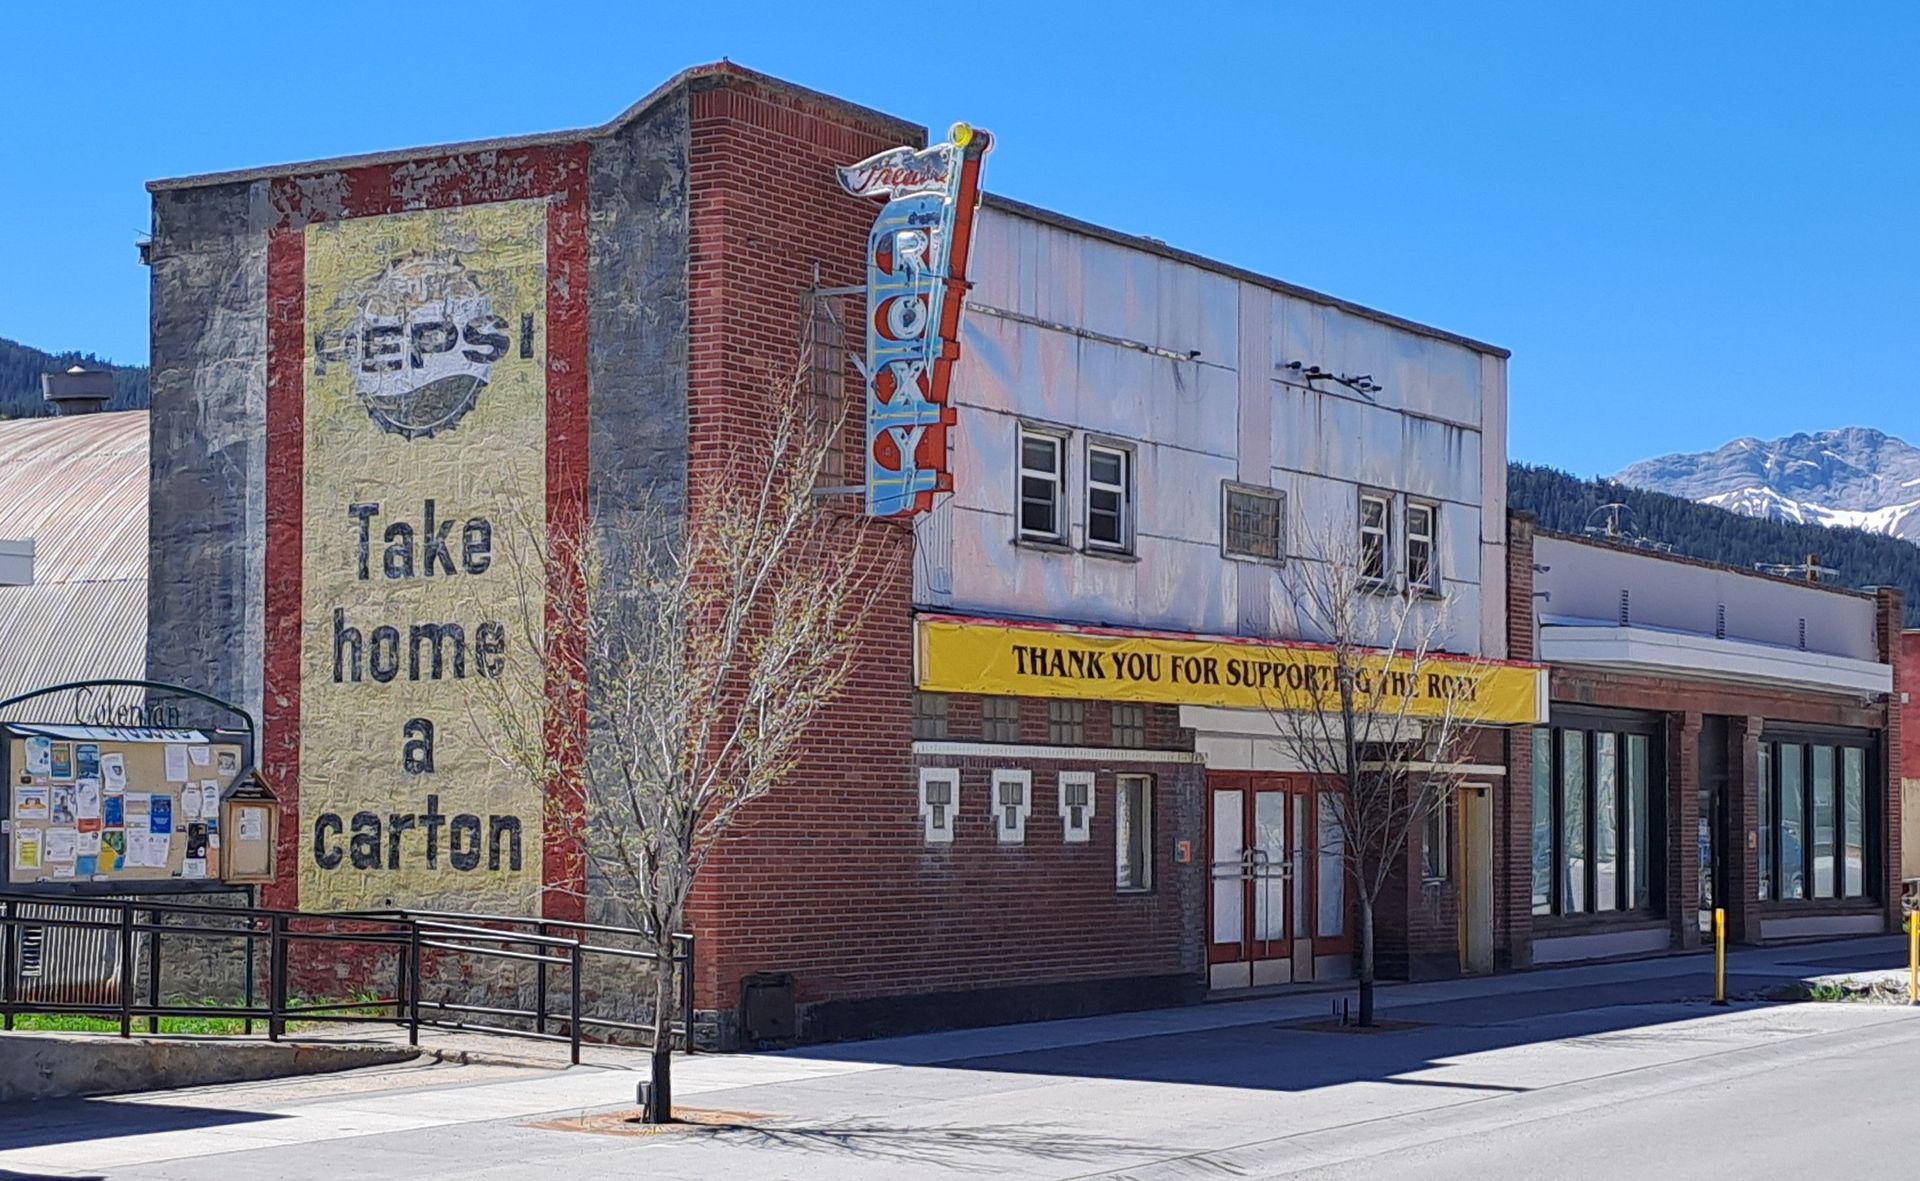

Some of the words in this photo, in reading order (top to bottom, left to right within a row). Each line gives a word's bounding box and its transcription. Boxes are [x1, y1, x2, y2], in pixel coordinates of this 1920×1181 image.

[314, 312, 534, 376] PEPSI
[888, 229, 934, 490] ROXY
[349, 499, 492, 580] Take
[333, 607, 505, 683] home
[1012, 645, 1106, 679] THANK
[1111, 652, 1161, 682] YOU
[1171, 655, 1220, 686] FOR
[1226, 658, 1371, 694] SUPPORTIG
[1378, 669, 1419, 698] THE
[403, 717, 435, 775] a
[314, 794, 522, 871] carton
